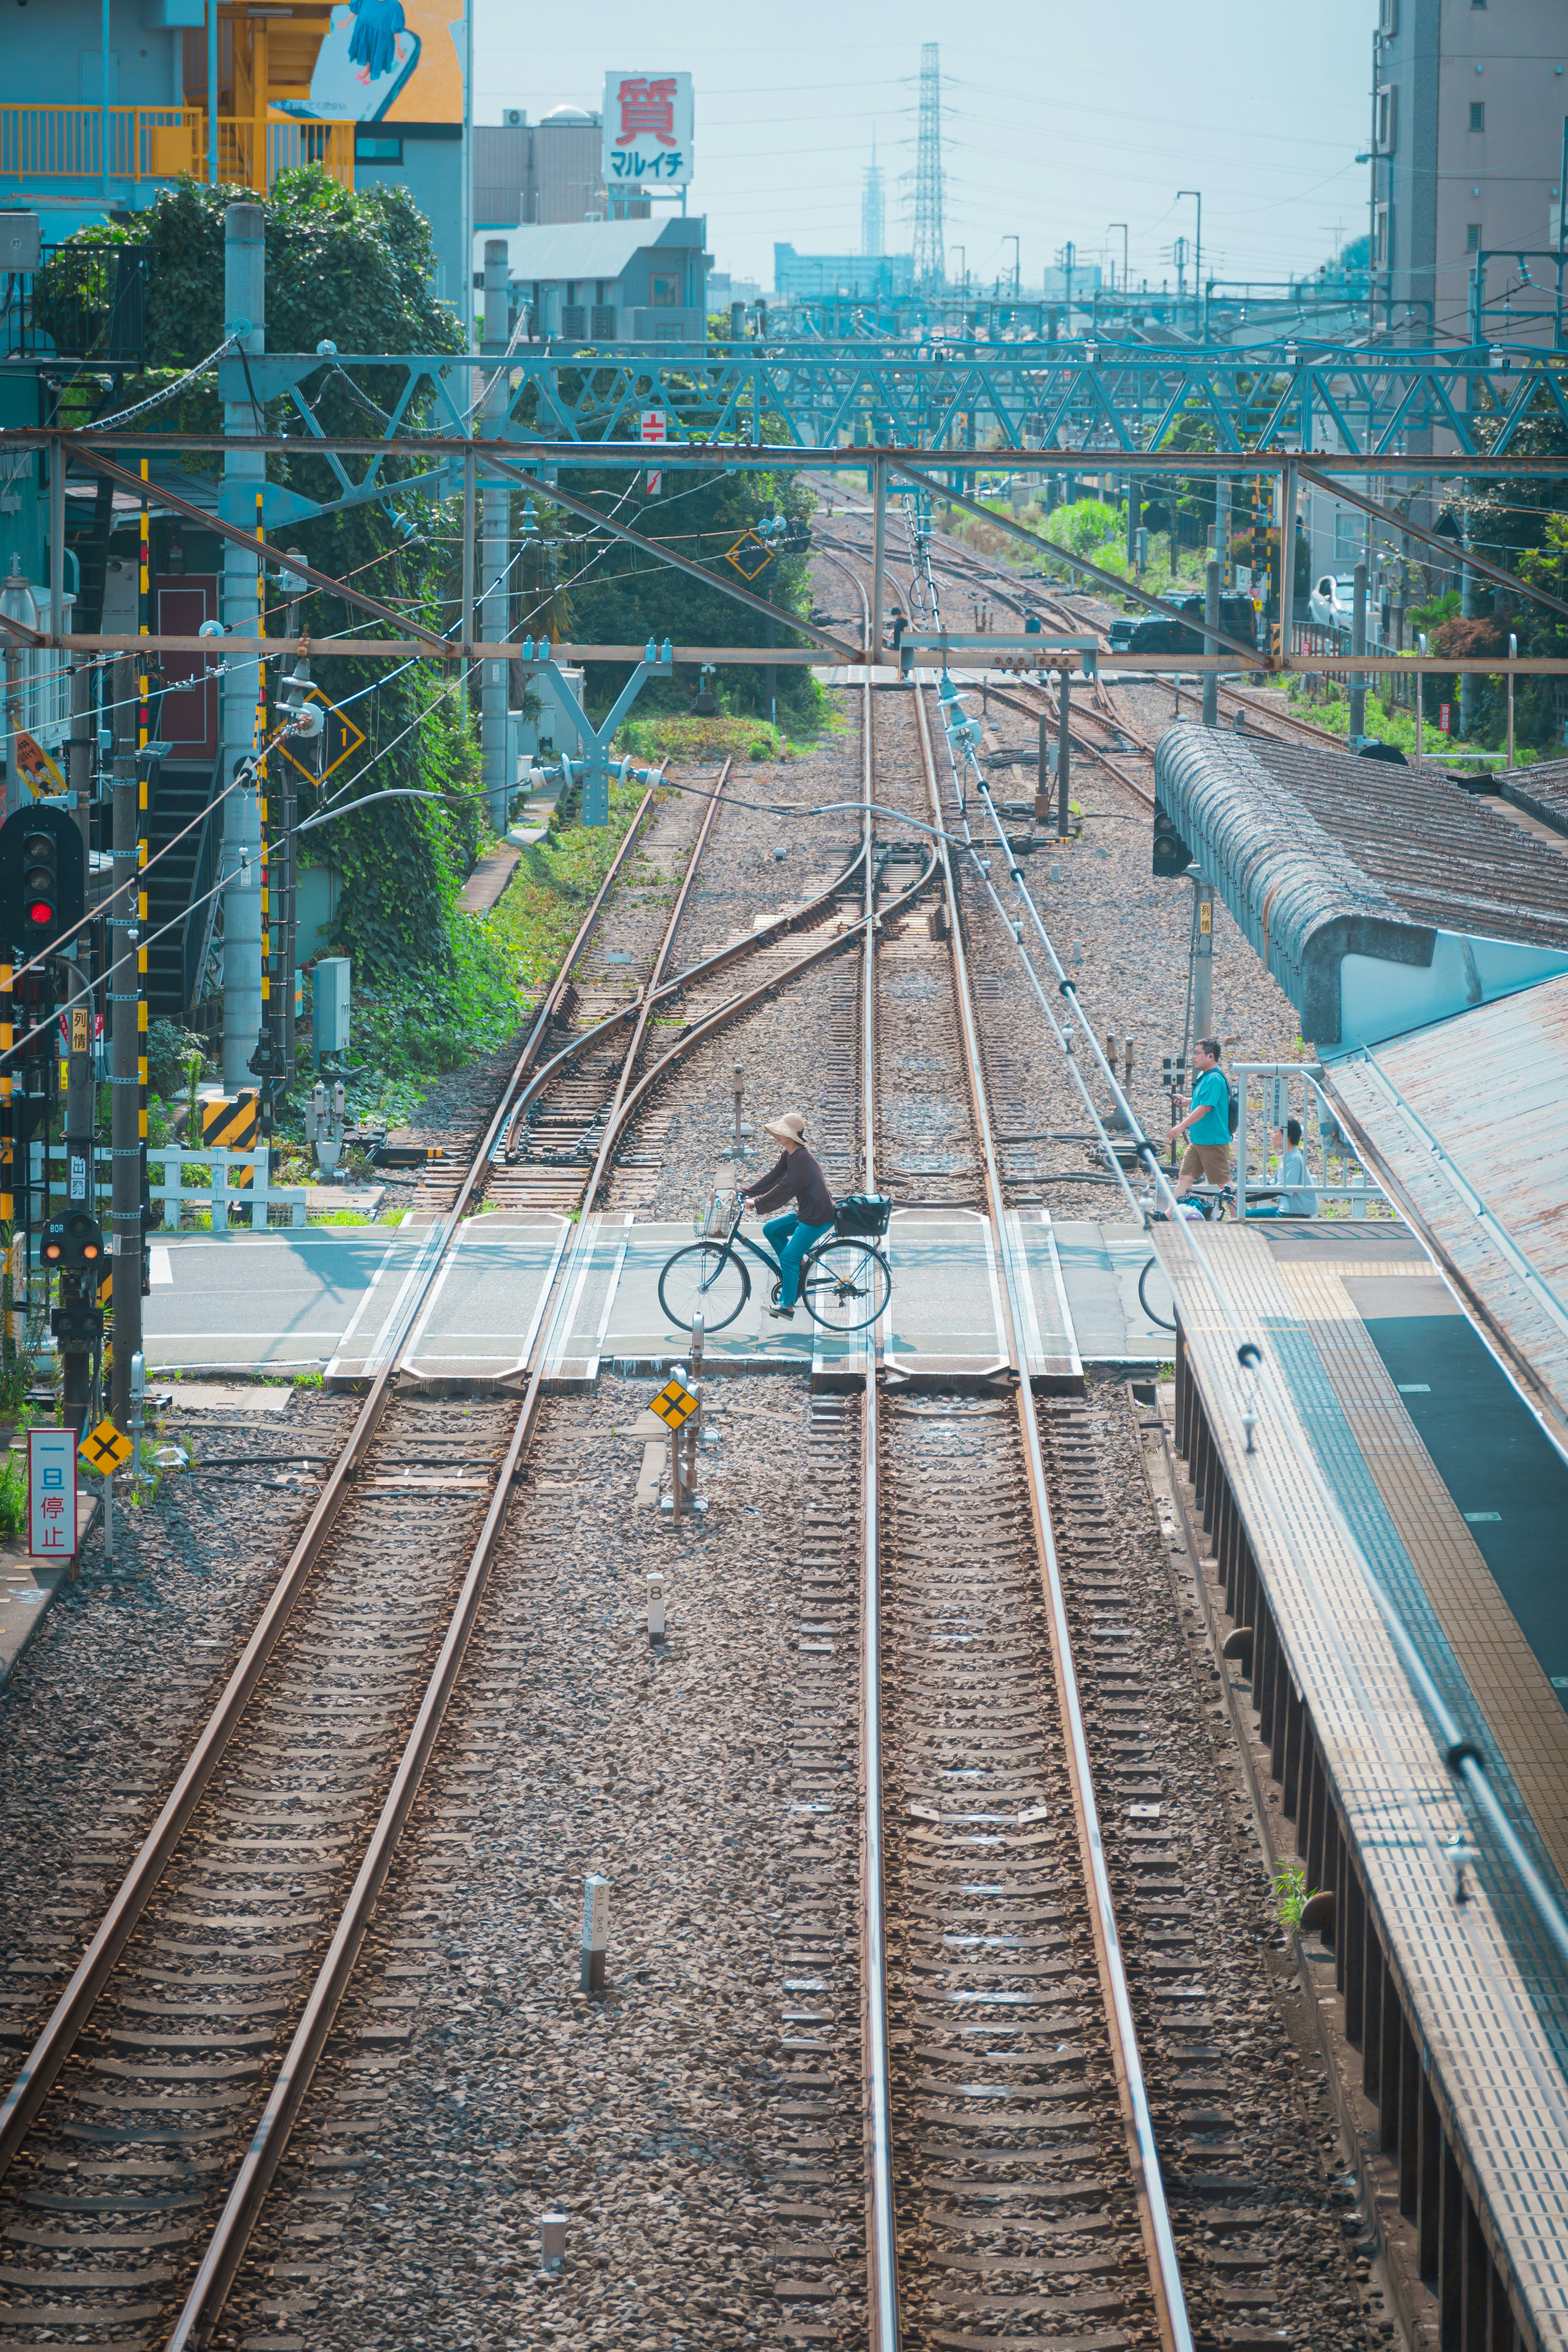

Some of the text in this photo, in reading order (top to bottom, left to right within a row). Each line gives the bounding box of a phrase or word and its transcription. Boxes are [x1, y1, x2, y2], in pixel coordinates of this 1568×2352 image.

[615, 78, 677, 147] 質
[610, 151, 683, 178] マルイチ
[12, 240, 20, 248] 灯
[732, 550, 740, 561] 2
[340, 728, 347, 746] 1
[1201, 905, 1210, 931] 列情
[74, 1012, 86, 1049] 列情
[50, 1224, 64, 1233] 80R
[40, 1447, 65, 1547] 一旦停止
[650, 1586, 662, 1600] 8
